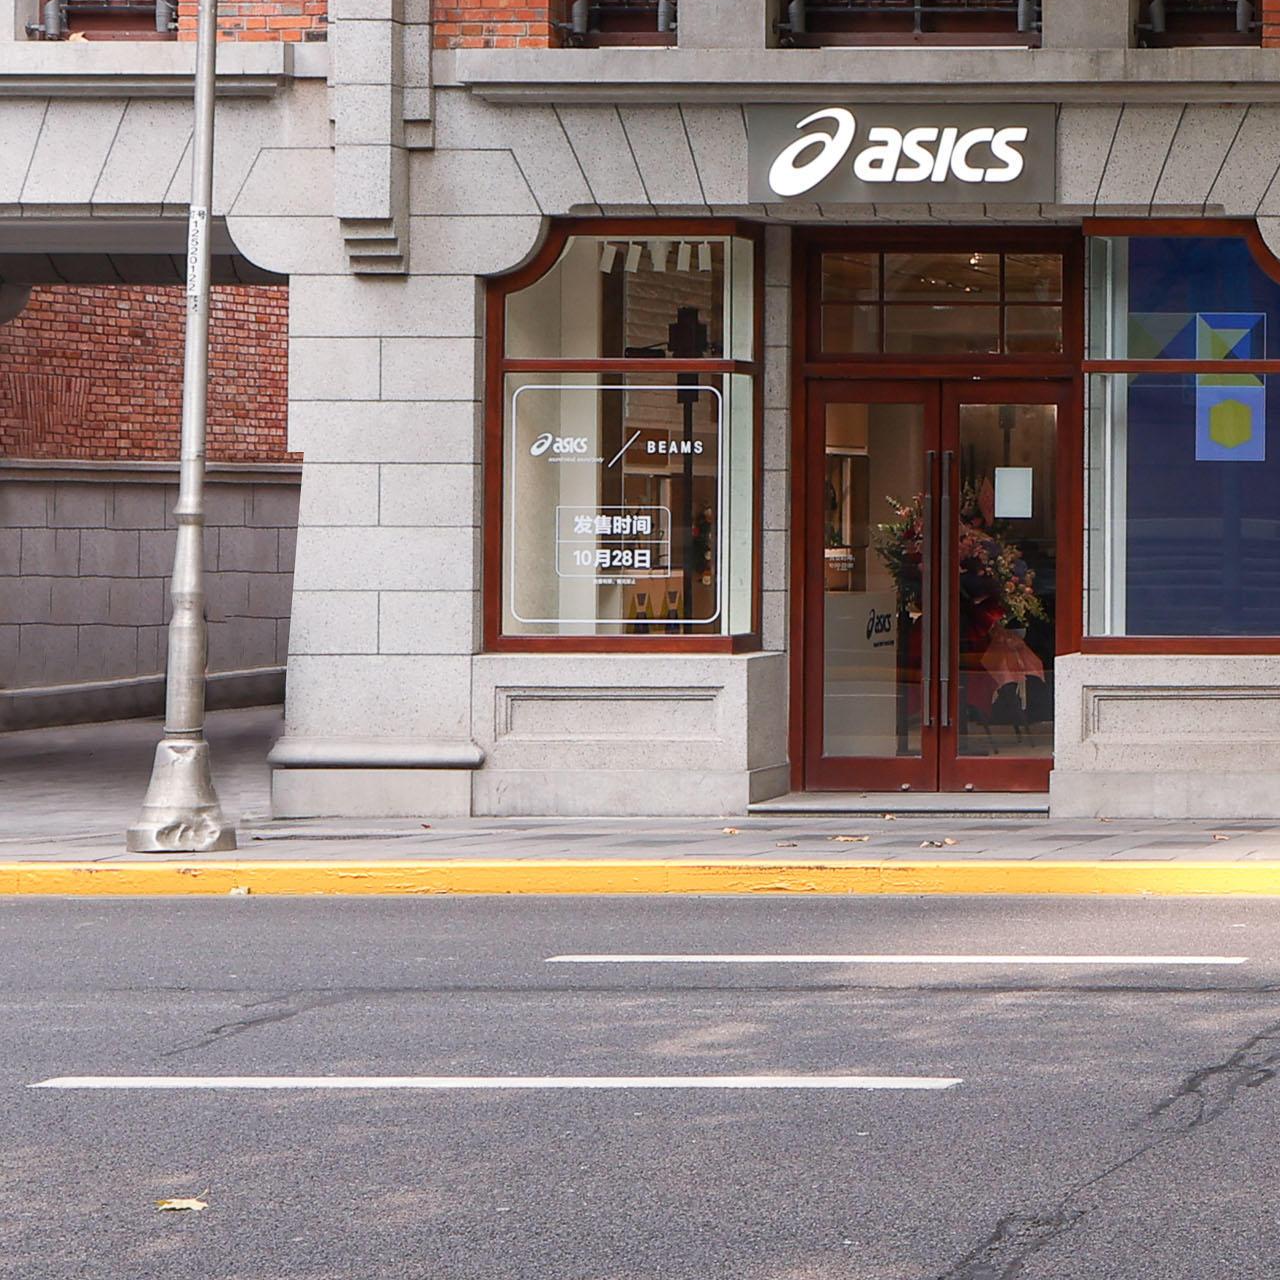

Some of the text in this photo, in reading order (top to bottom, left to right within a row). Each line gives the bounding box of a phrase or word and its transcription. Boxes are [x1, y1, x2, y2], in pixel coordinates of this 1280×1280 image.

[854, 127, 1028, 182] asics
[647, 440, 703, 454] BEAMS
[574, 515, 651, 535] 发售时间
[573, 549, 651, 568] 10月28日
